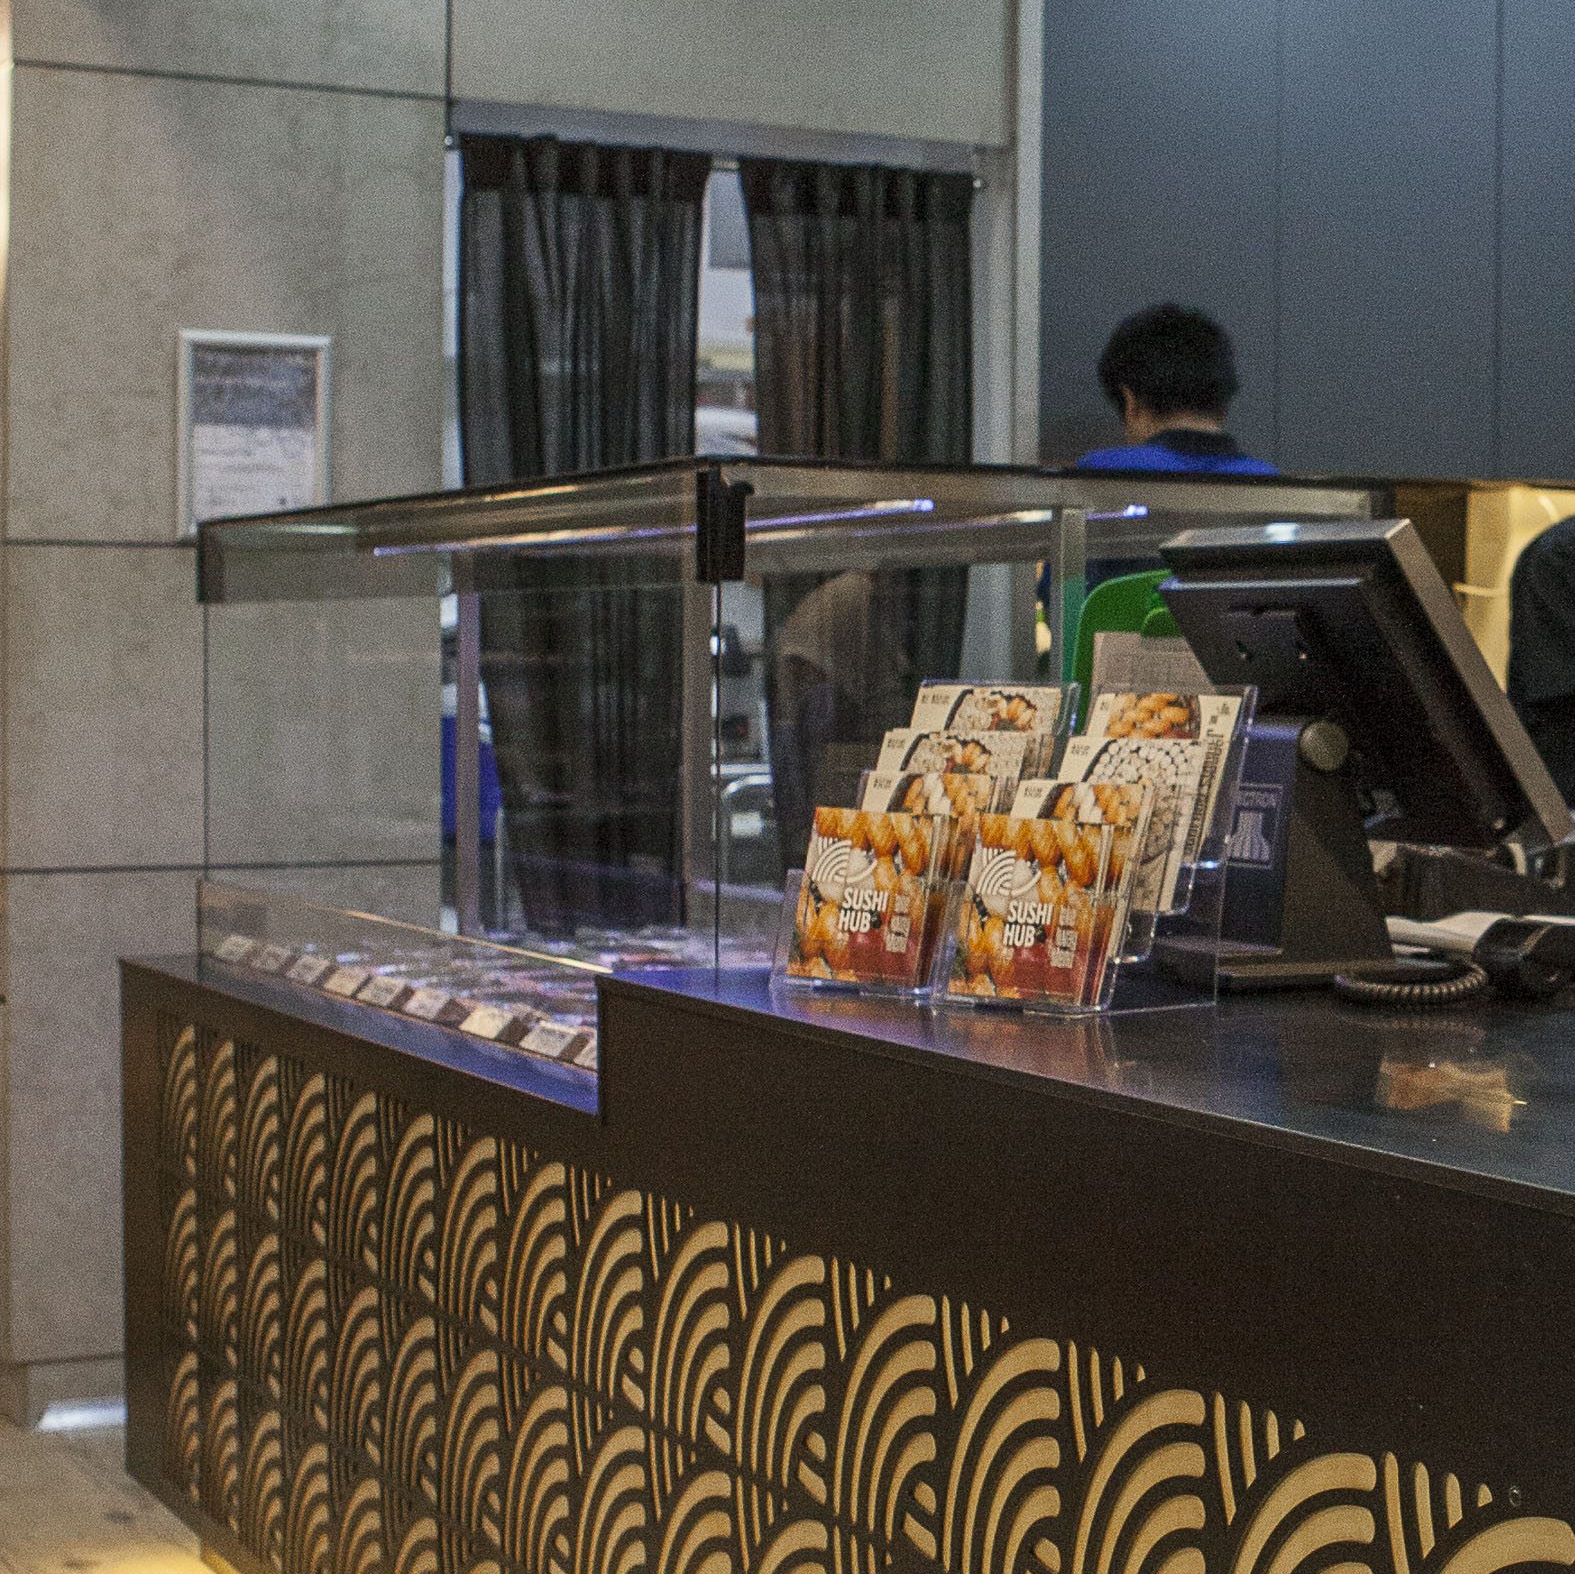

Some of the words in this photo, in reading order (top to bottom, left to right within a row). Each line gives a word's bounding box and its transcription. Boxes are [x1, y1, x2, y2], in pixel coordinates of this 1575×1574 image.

[841, 887, 889, 912] SUSHI
[838, 909, 872, 933] HUB
[1007, 900, 1054, 925] SUSHI
[1003, 923, 1036, 947] HUB
